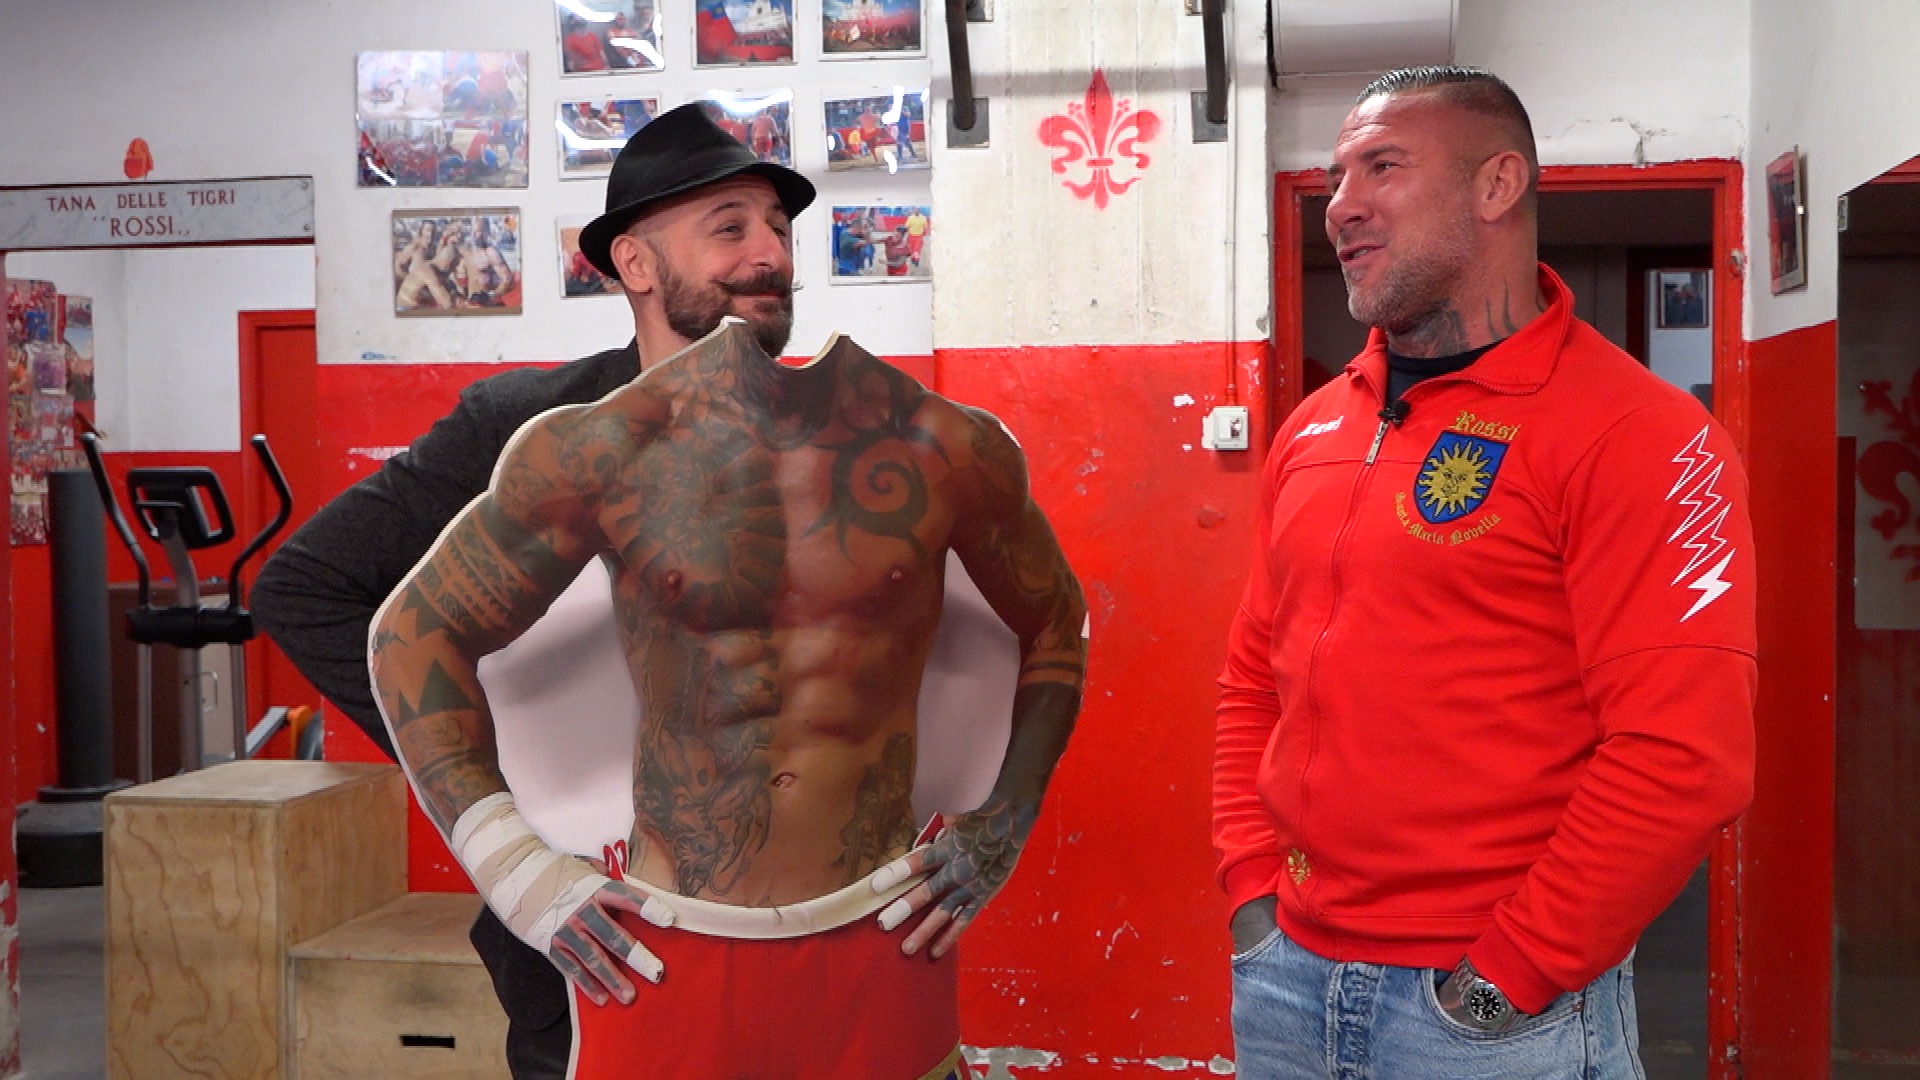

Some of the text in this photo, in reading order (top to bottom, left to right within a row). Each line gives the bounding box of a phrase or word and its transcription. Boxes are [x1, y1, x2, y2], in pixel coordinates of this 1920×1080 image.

[47, 189, 236, 212] TANA DELLE TIGRI
[1448, 410, 1521, 441] Rossi
[1407, 522, 1444, 544] Maria
